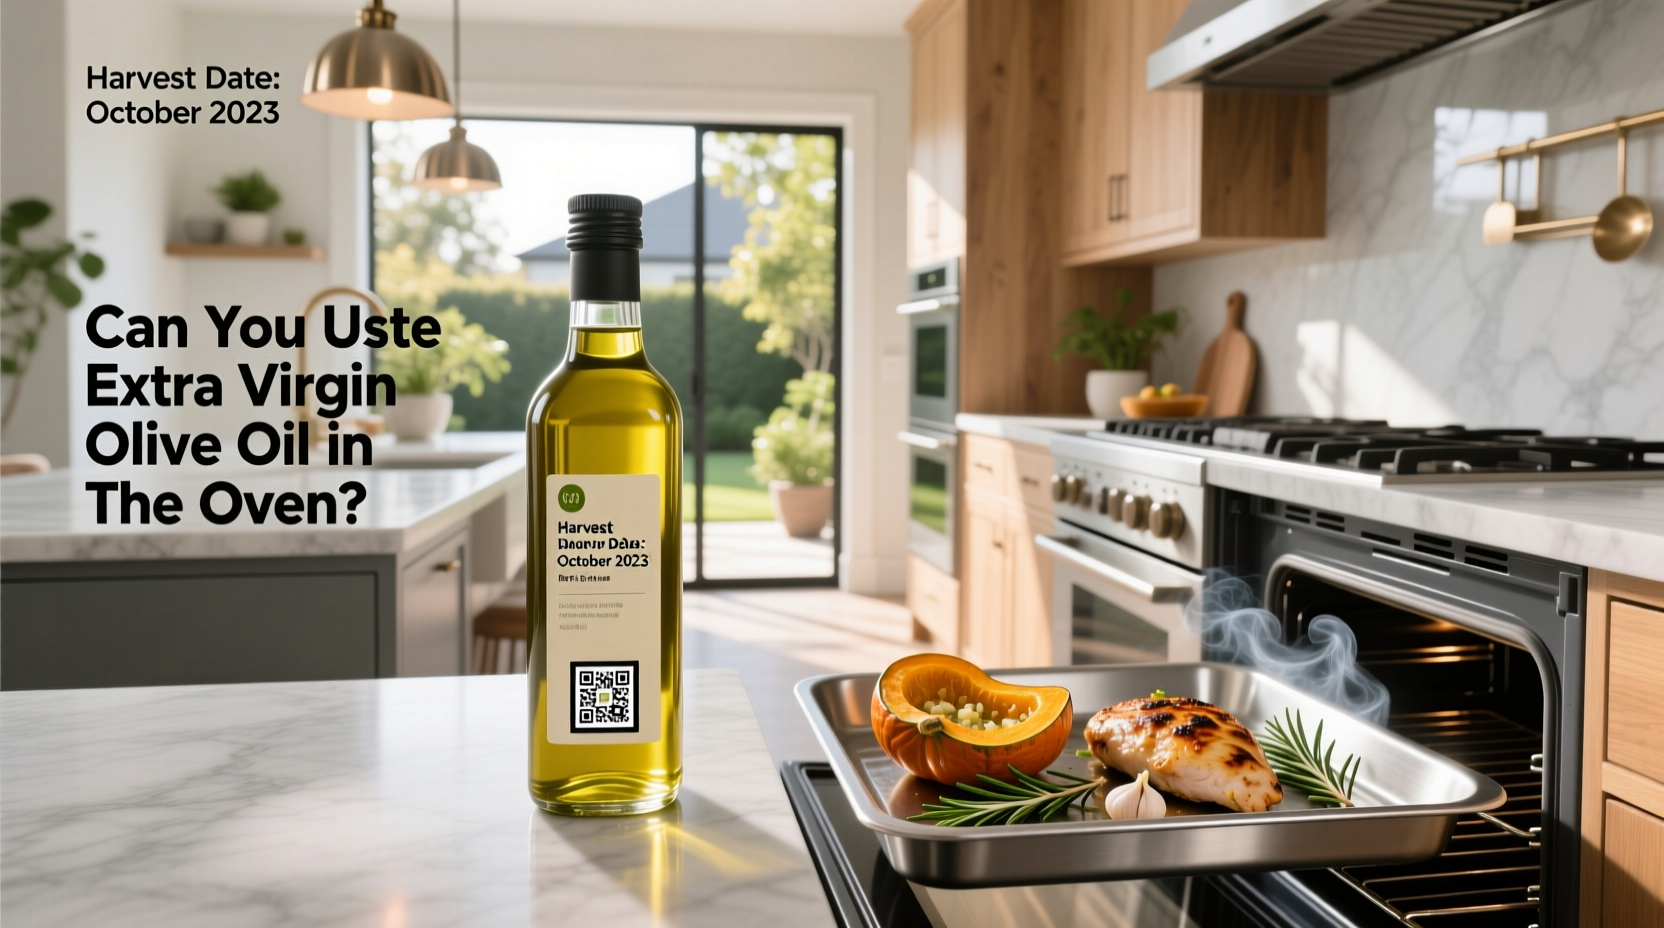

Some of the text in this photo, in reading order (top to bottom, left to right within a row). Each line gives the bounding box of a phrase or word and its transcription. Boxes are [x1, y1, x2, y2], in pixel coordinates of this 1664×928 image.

[557, 520, 614, 534] Harvest
[556, 553, 649, 568] October 2023
